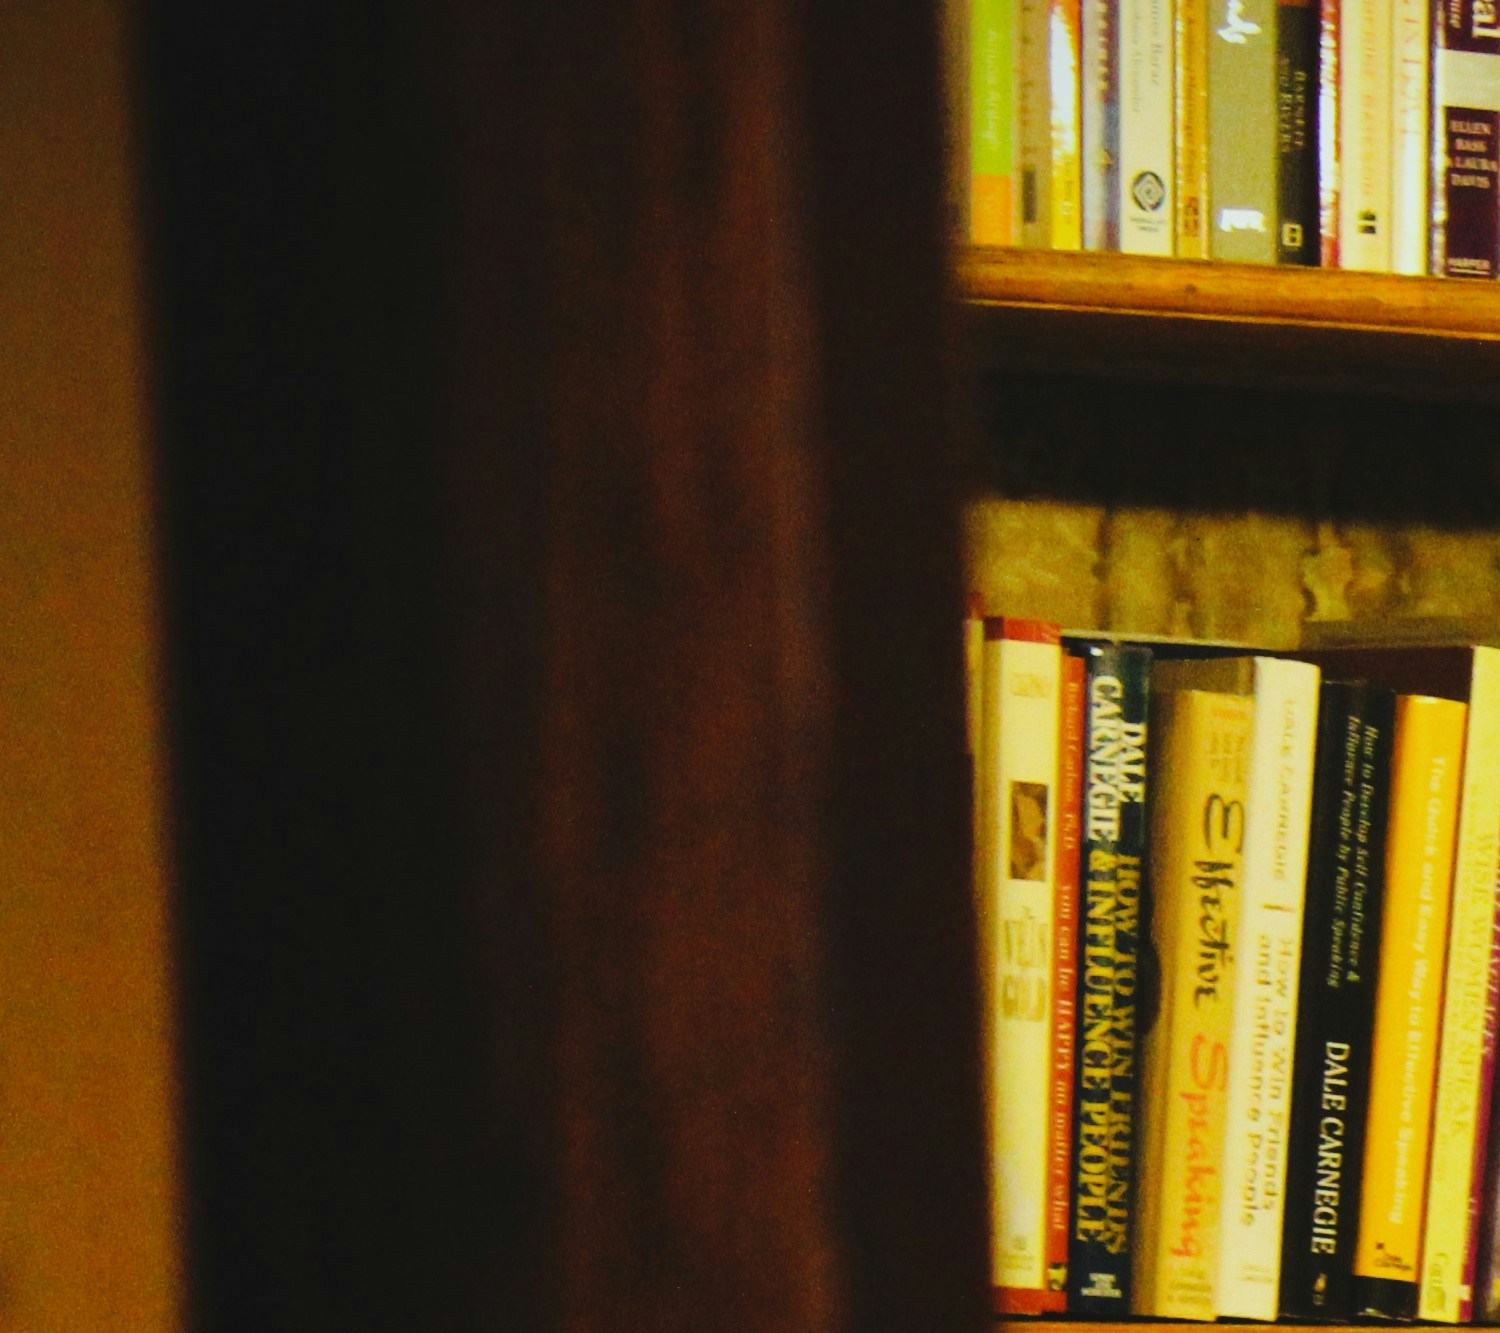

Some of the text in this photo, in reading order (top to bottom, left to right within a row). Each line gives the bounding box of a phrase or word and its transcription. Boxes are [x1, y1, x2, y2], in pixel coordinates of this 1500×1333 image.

[1088, 674, 1120, 842] CARNEGIE
[1117, 722, 1145, 803] DALE
[1083, 878, 1115, 1089] INFLUENCE
[1170, 794, 1243, 1259] Effective Speaking
[1077, 1100, 1110, 1243] PEOPLE
[1311, 1040, 1350, 1255] DALE CARNEGIE
